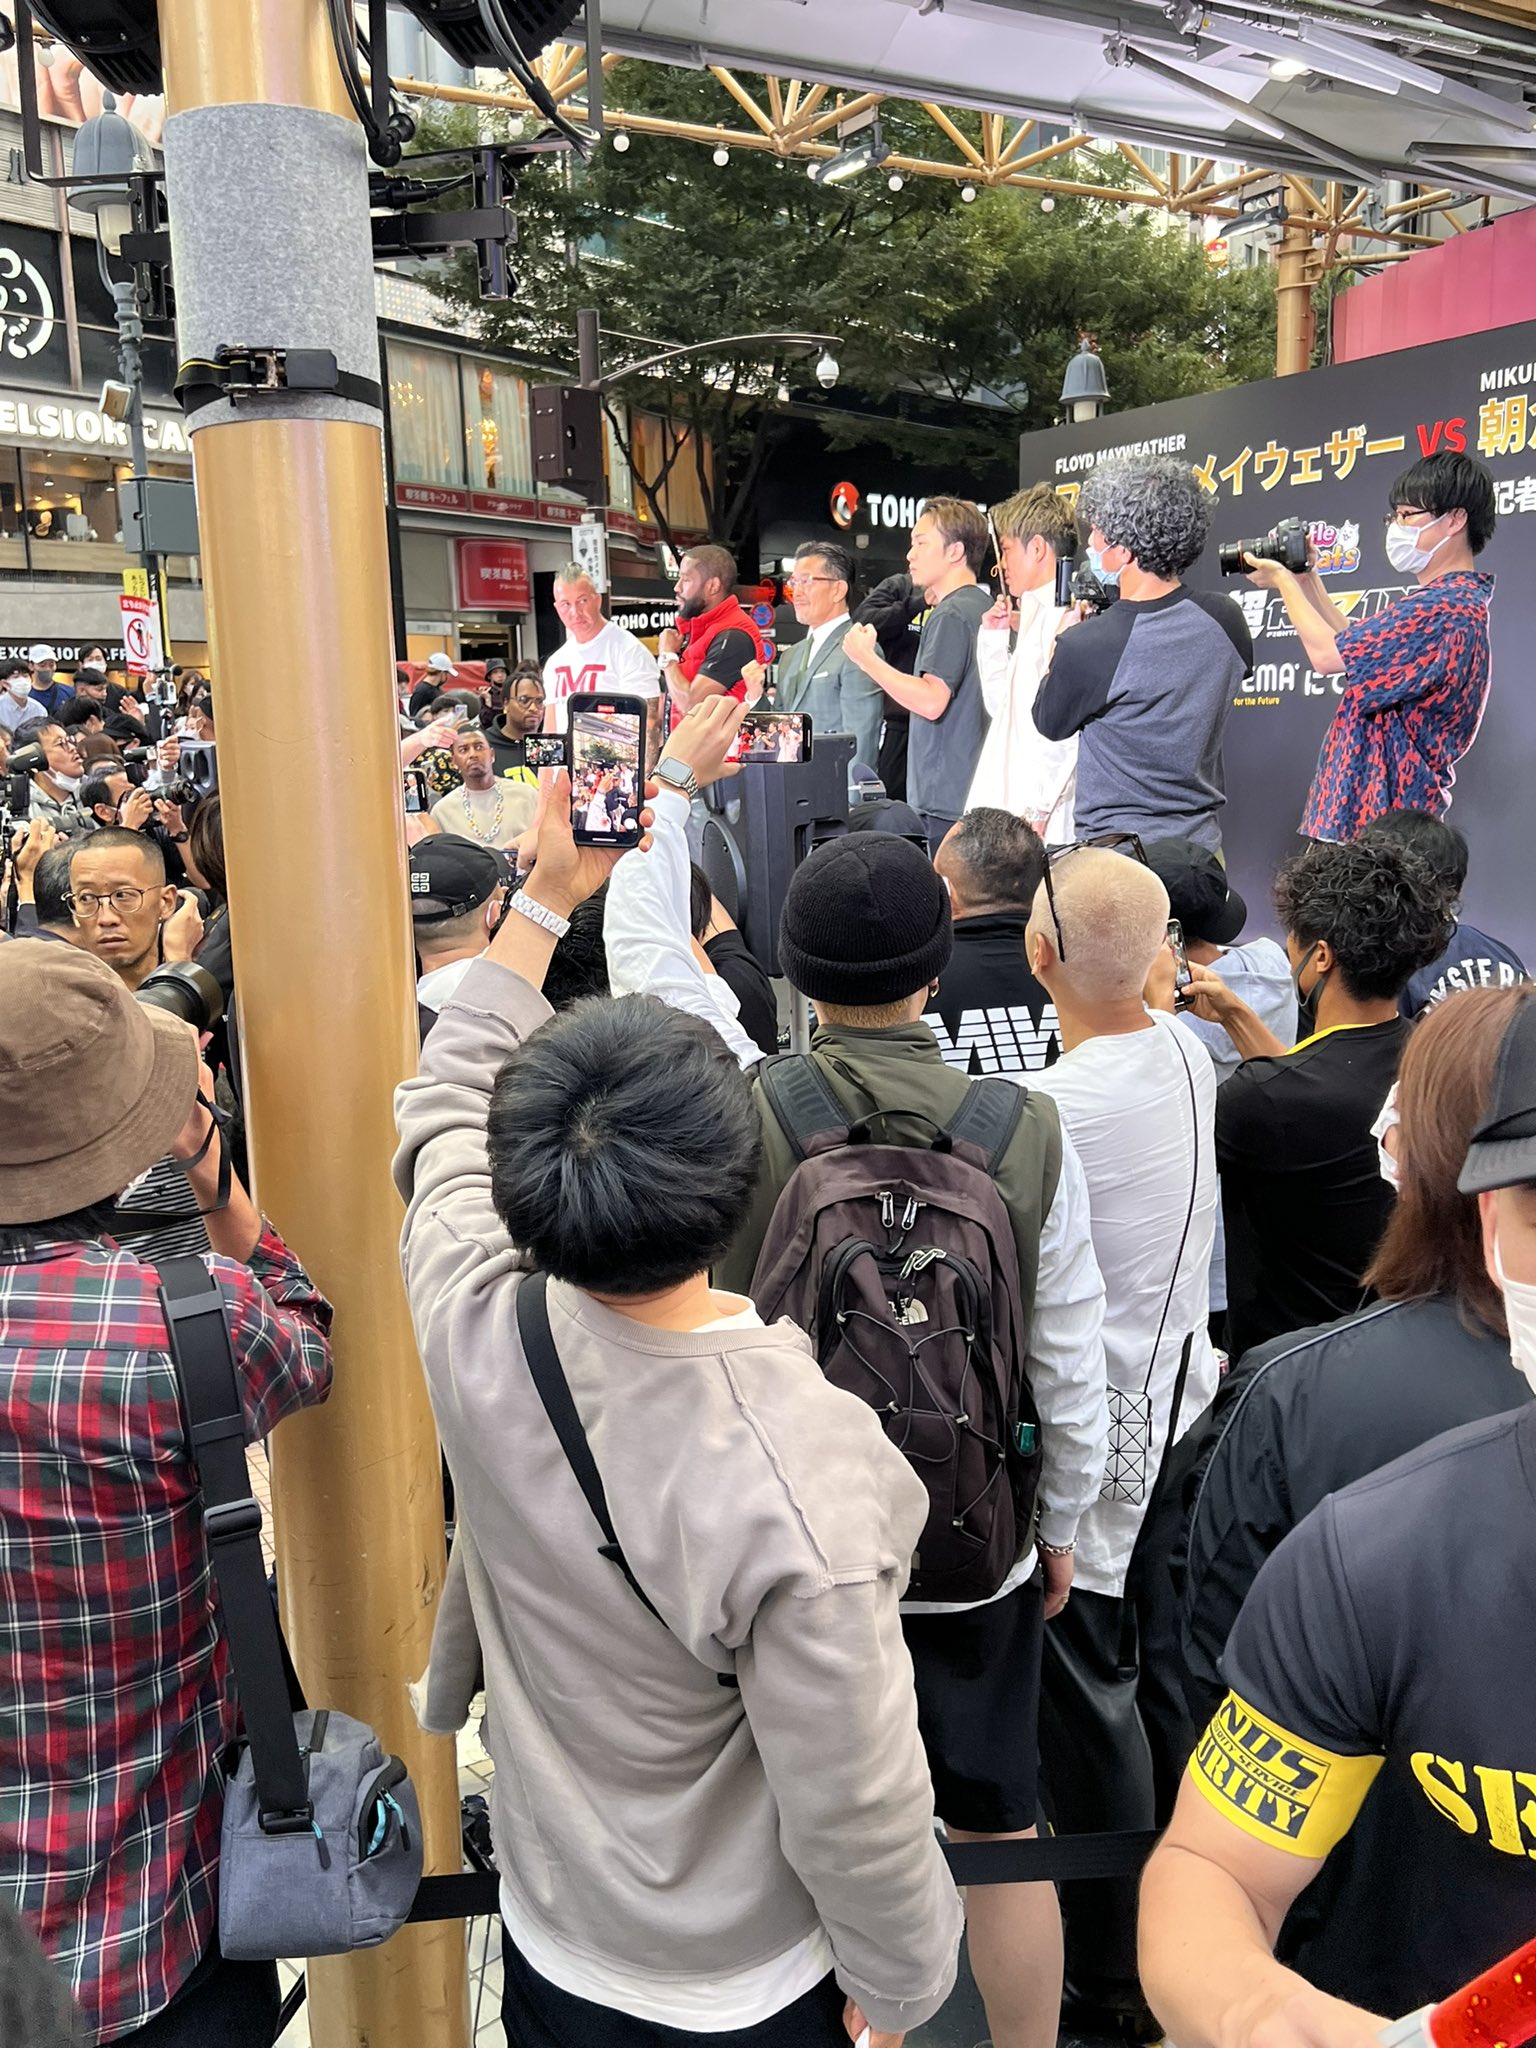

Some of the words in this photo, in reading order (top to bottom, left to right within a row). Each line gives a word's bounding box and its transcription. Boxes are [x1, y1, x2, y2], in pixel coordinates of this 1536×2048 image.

[1480, 362, 1536, 392] MIKU
[1191, 423, 1405, 496] メイウェザー
[1416, 417, 1467, 458] VS
[1477, 394, 1536, 458] 朝
[1055, 454, 1095, 475] FLOYD
[611, 613, 648, 629] TOHO
[1238, 1754, 1303, 1798] SERVICE
